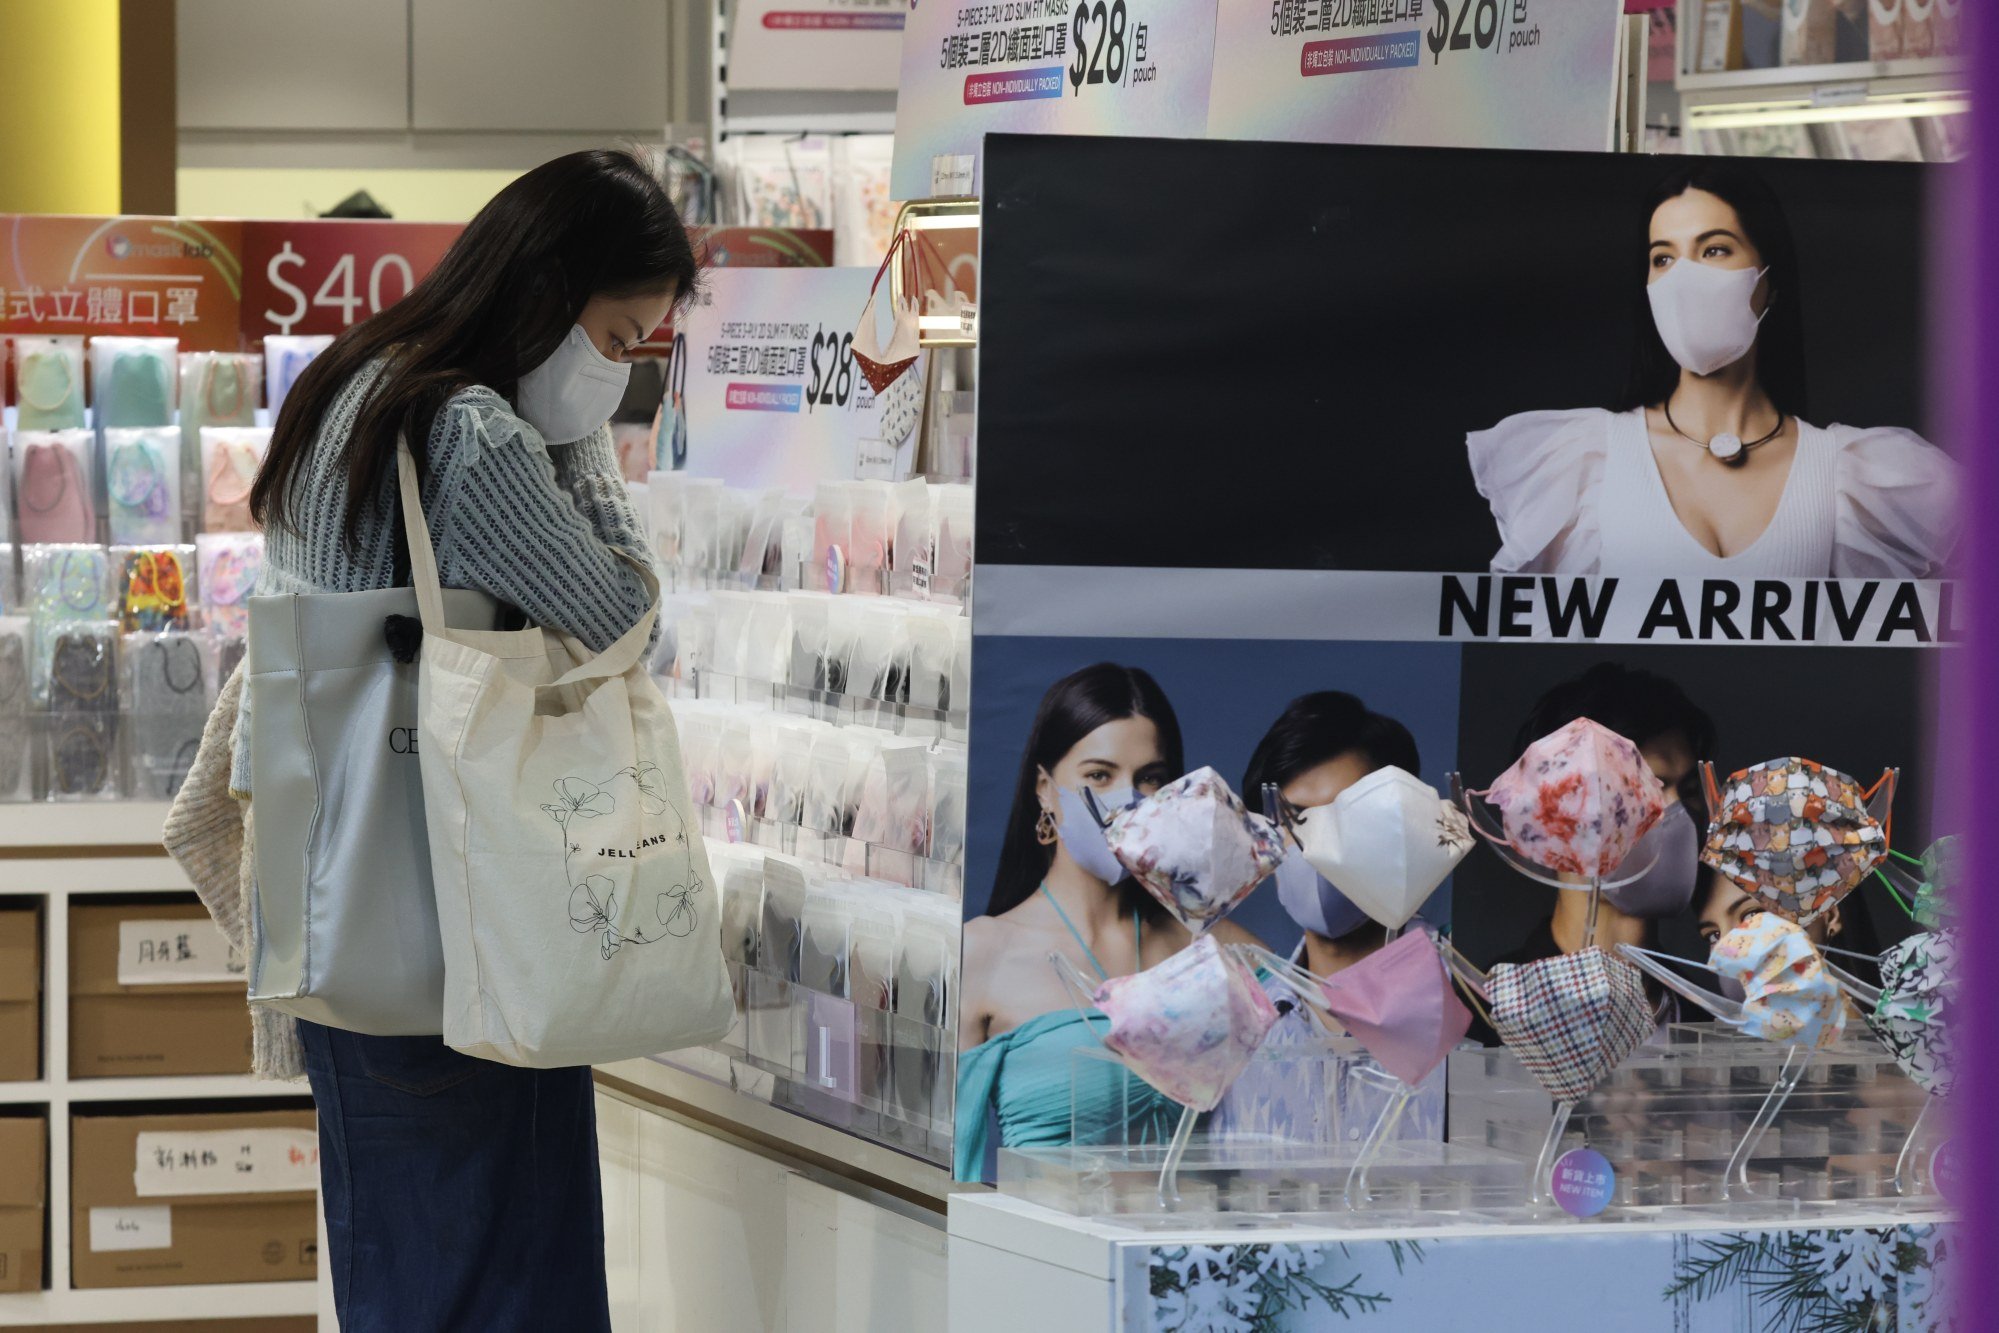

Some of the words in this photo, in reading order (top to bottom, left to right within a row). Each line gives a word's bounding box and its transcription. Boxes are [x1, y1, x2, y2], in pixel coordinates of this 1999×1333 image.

[1004, 3, 1015, 22] 2D
[1015, 1, 1032, 20] SLIM
[1508, 23, 1540, 54] pouch
[1132, 61, 1157, 84] pouch
[0, 286, 200, 325] 式立體口罩
[1438, 574, 1620, 638] NEW
